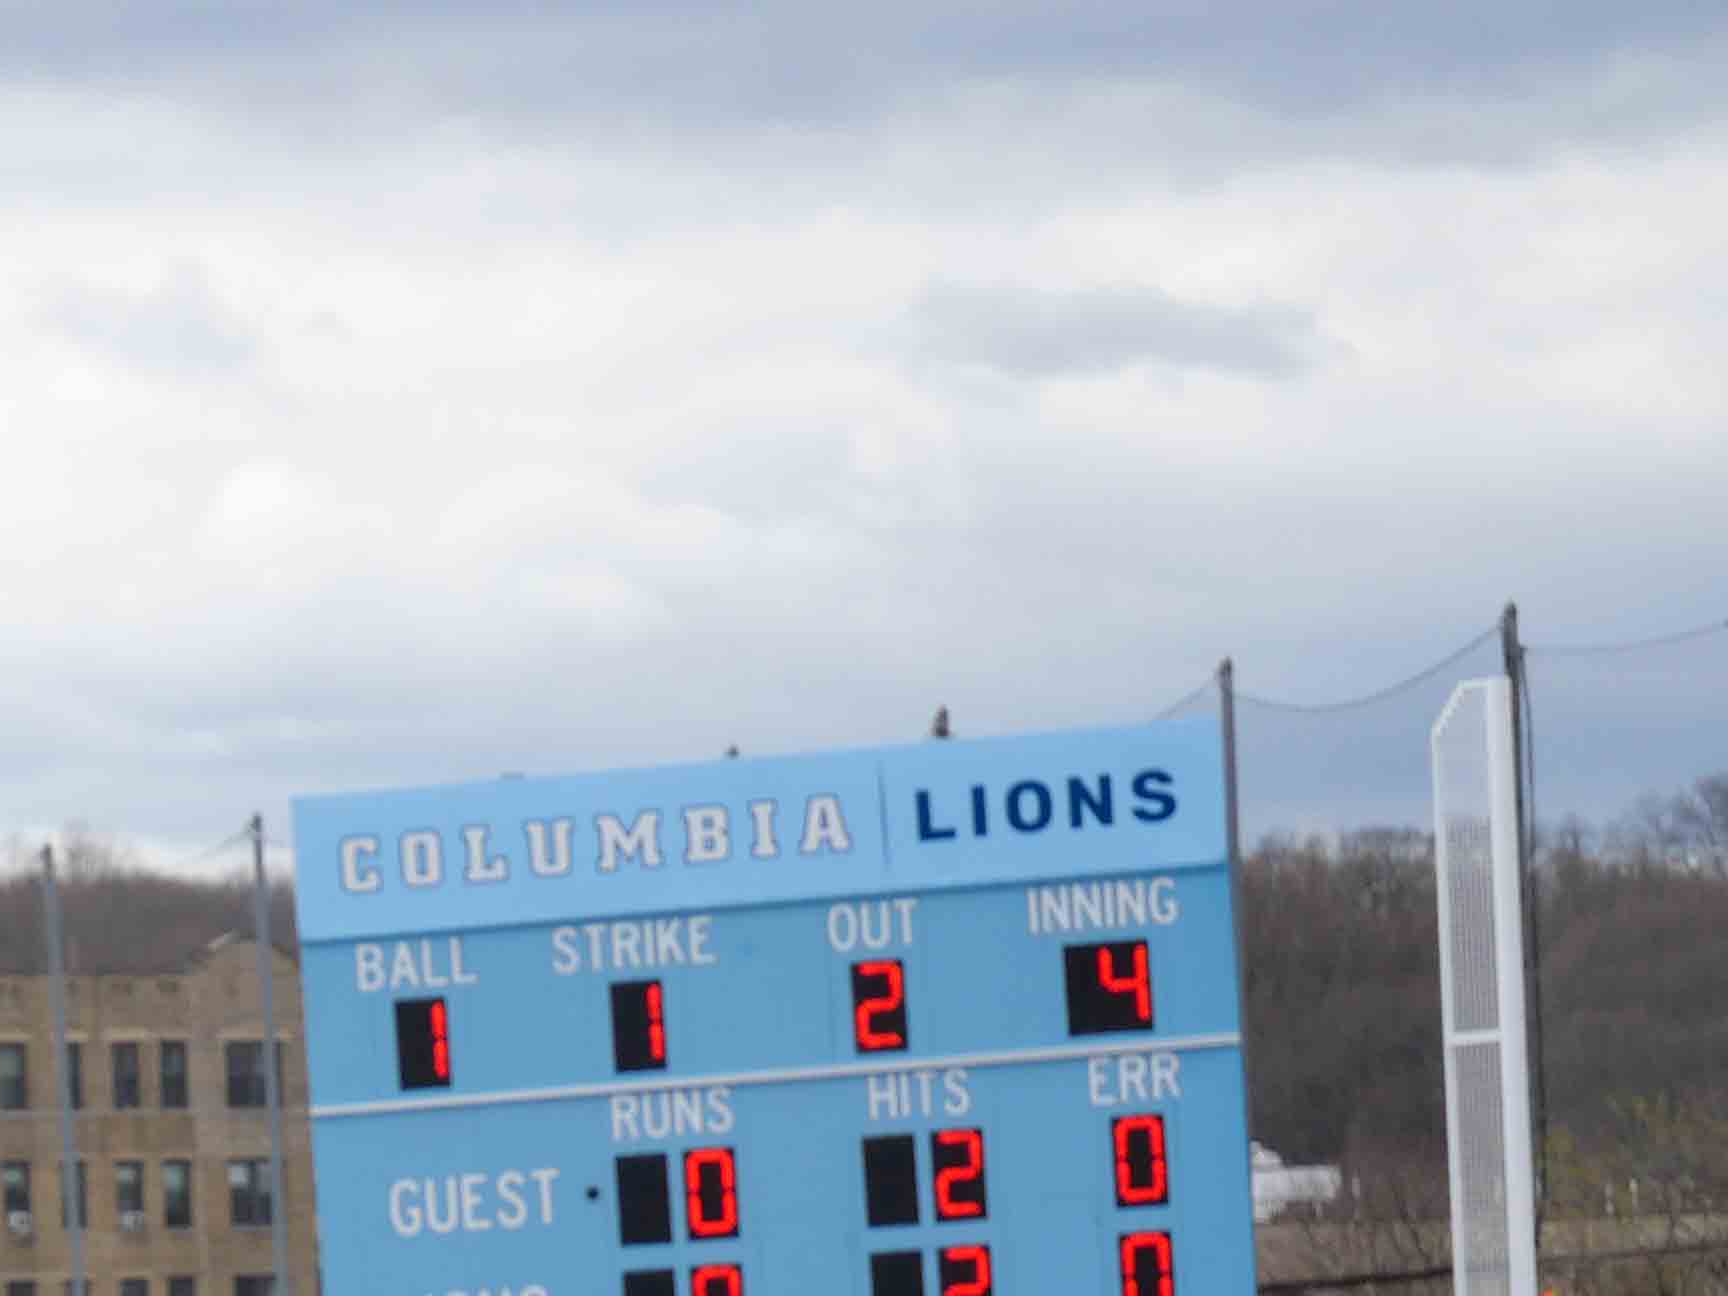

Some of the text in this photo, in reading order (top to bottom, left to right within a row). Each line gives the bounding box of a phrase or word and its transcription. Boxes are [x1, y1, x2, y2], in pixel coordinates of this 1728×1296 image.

[341, 768, 1177, 893] COLUMBIA LIONS
[355, 876, 1179, 993] BALL STRIKE OUT INNING
[429, 942, 1153, 1080] 1 1 2 4
[609, 1052, 1182, 1142] RUNS HITS ERR
[388, 1168, 560, 1238] GUEST
[684, 1114, 1168, 1237] 0 2 0
